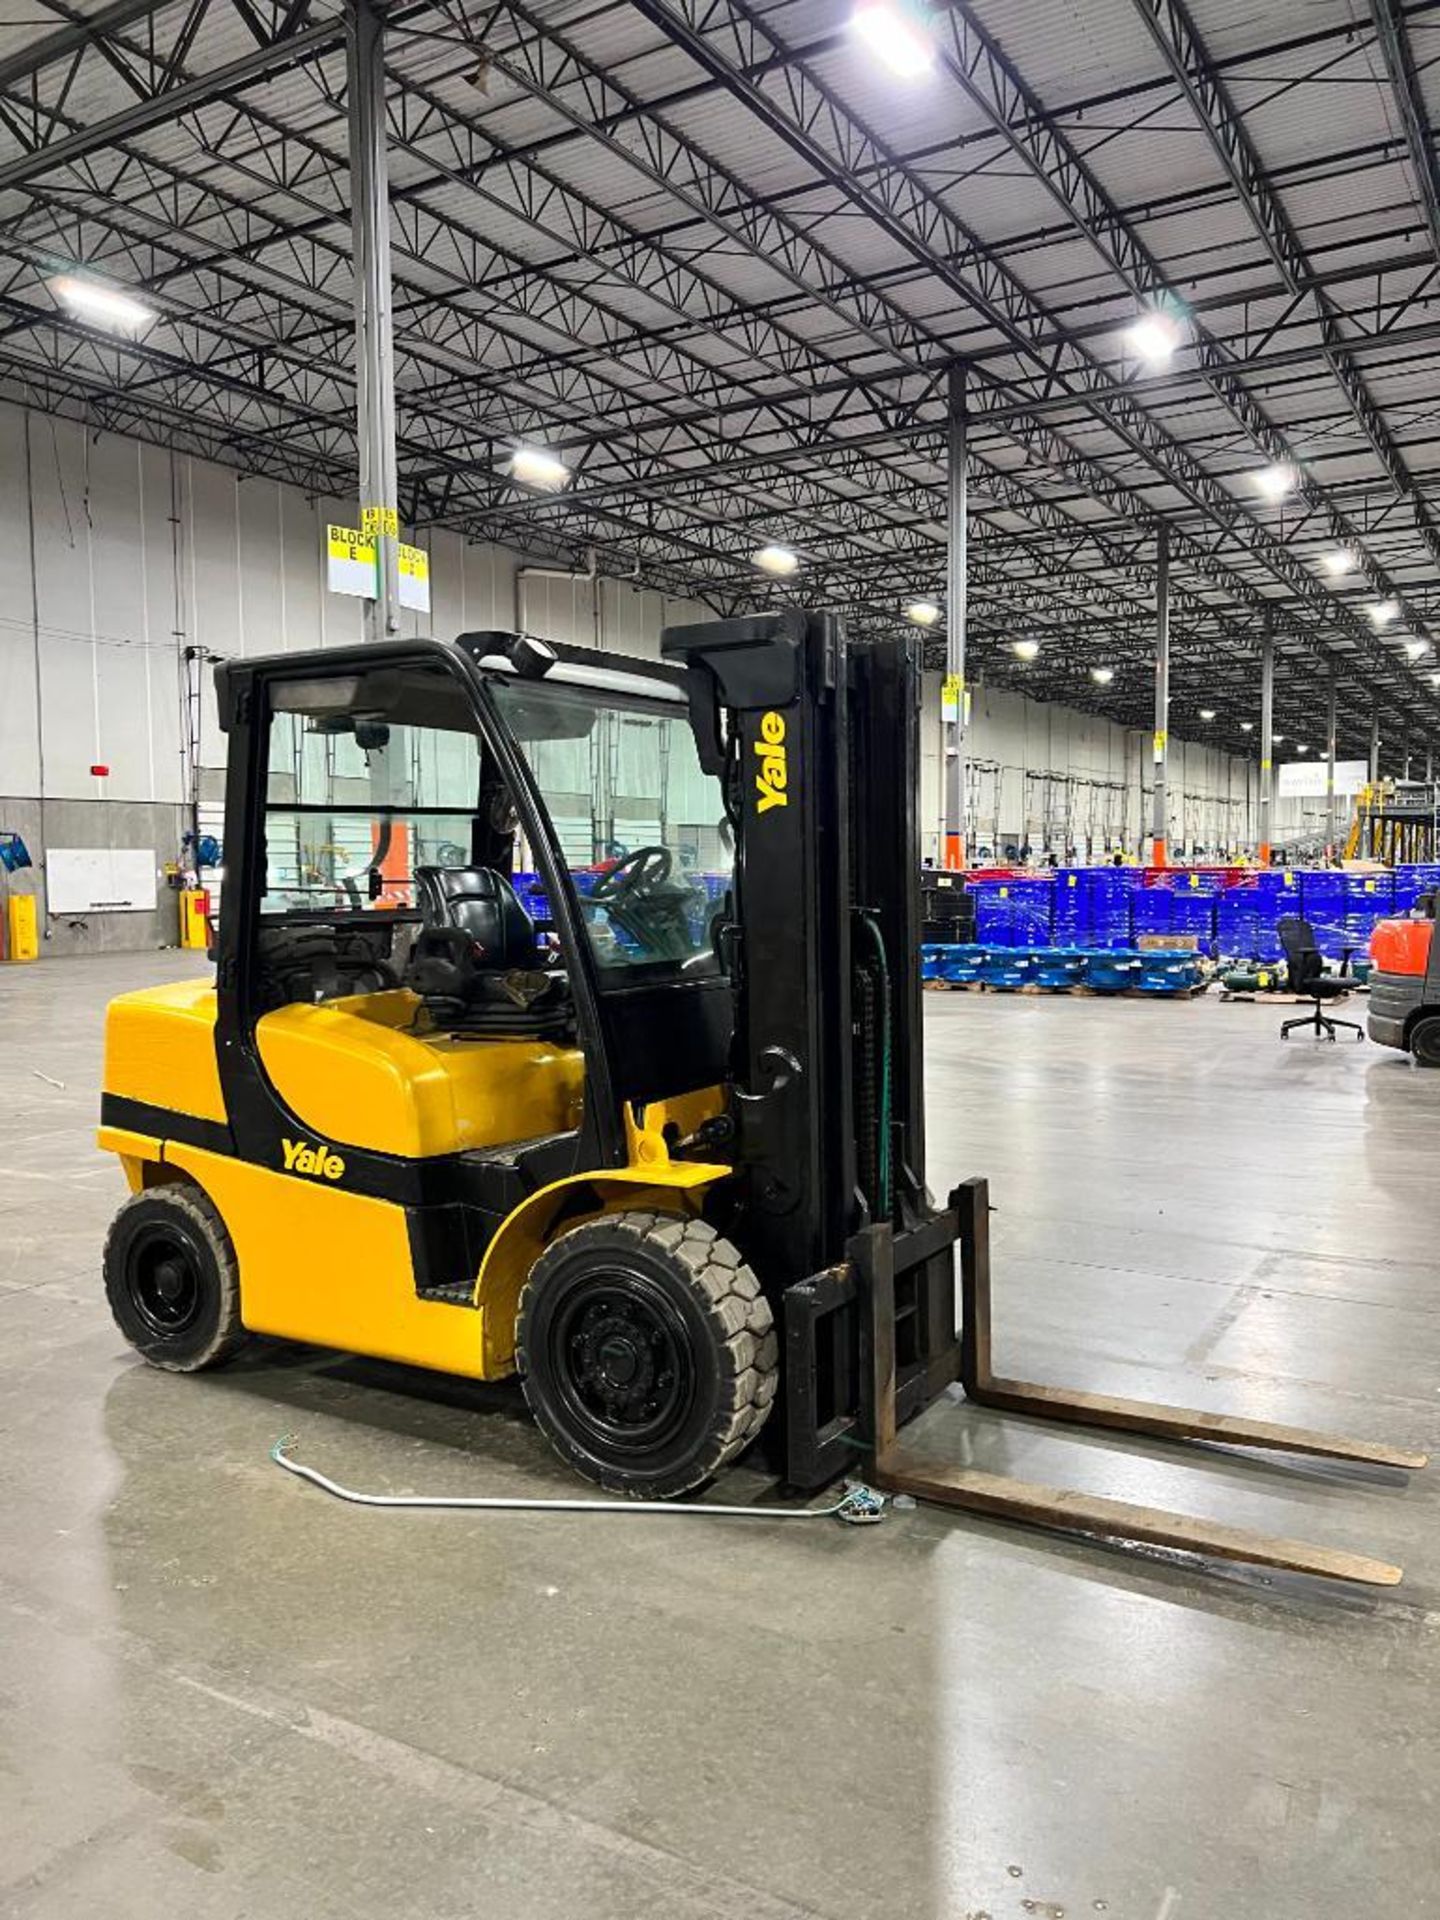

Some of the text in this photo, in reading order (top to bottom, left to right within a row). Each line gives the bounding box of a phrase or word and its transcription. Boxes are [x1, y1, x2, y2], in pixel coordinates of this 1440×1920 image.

[330, 527, 375, 549] BLOCK
[349, 546, 357, 561] E
[754, 711, 787, 813] Yale
[282, 1138, 345, 1179] Yale
